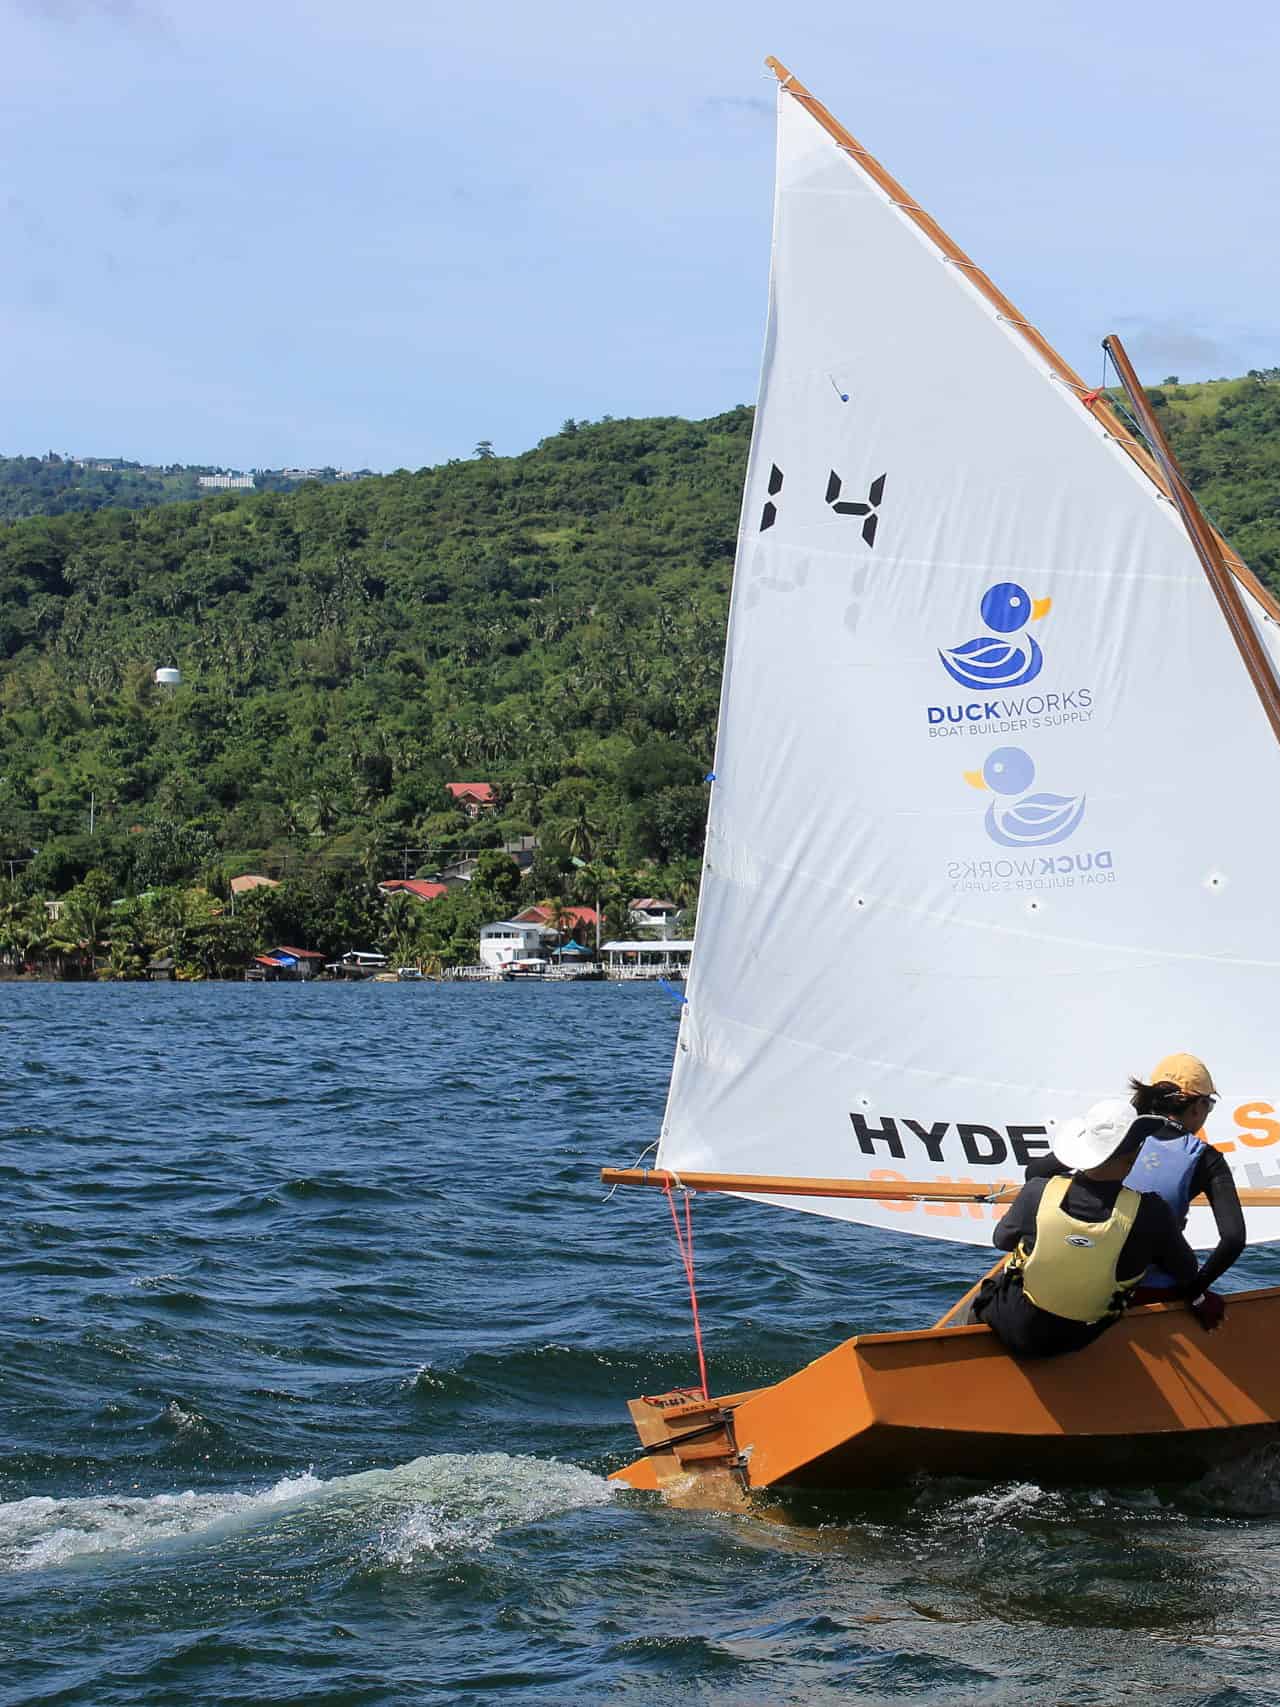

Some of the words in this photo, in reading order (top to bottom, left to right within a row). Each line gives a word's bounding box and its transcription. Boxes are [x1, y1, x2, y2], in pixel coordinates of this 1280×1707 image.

[927, 688, 1093, 725] DUCKWORKS
[928, 725, 965, 738] BOAT
[969, 718, 1041, 736] BUILDER'S
[1044, 709, 1094, 728] SUPPLY
